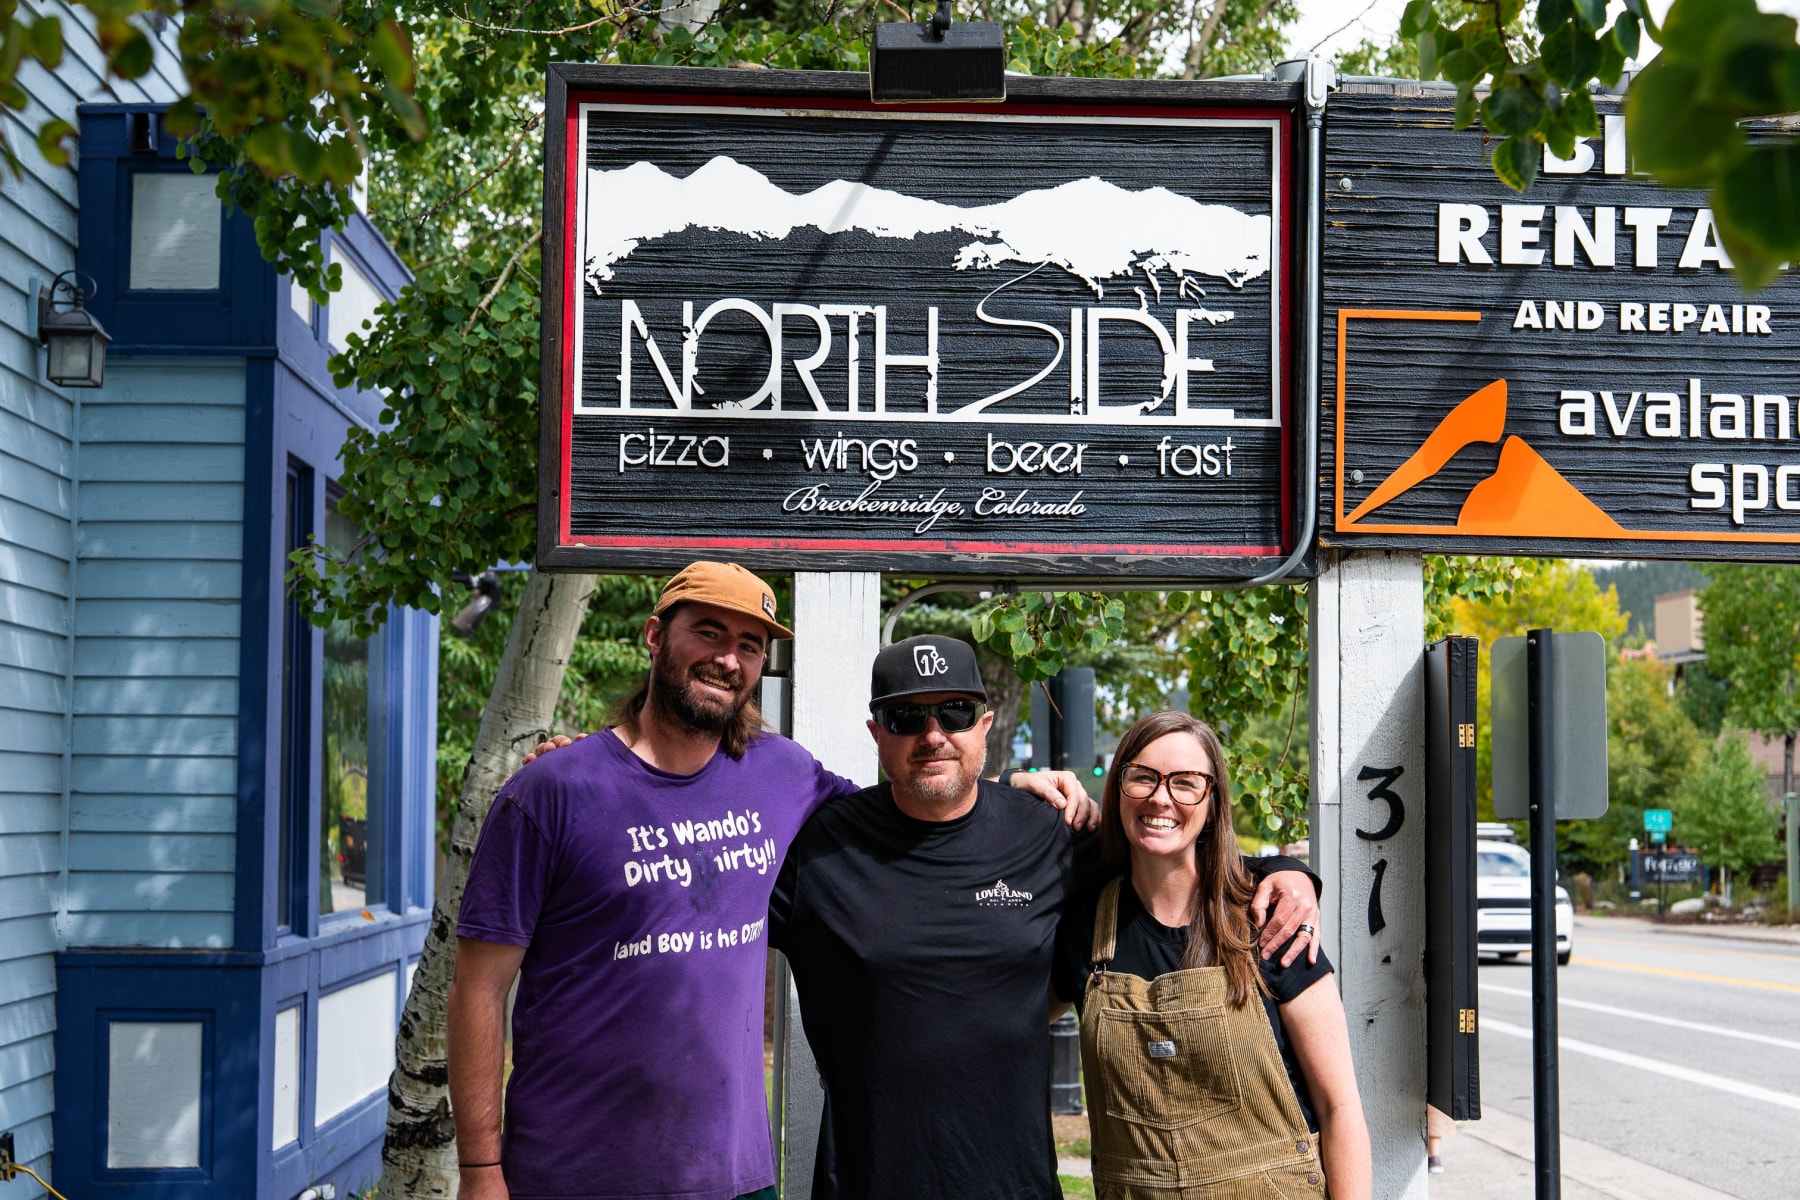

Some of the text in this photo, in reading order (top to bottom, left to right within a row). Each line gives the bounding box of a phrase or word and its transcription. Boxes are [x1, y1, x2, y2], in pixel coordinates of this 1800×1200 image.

[1437, 202, 1790, 270] RENTA
[1513, 299, 1774, 335] AND REPAIR
[1558, 378, 1800, 441] avalan
[618, 427, 1237, 481] pizza wings beer fast
[782, 480, 1088, 534] Breckenridge, Colorado
[626, 808, 762, 853] It's Wando's
[623, 853, 692, 888] Dirty
[657, 931, 695, 954] BOY
[699, 930, 713, 950] is
[717, 927, 738, 949] he
